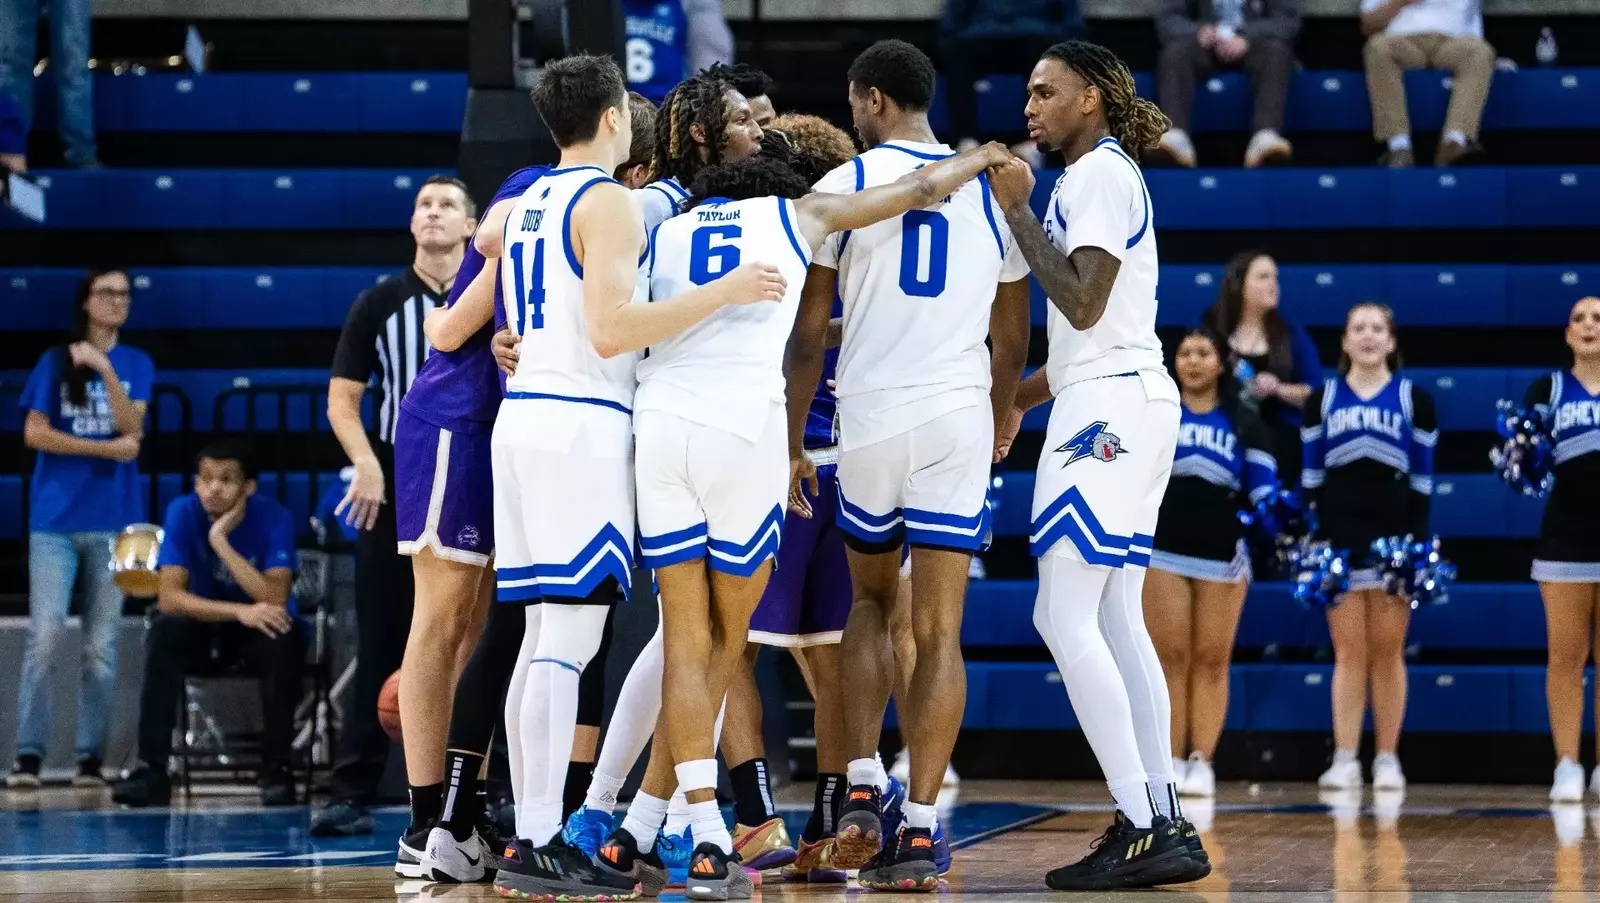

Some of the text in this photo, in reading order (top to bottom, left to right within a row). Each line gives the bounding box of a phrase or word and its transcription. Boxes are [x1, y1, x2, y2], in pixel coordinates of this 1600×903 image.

[520, 208, 547, 233] DUB
[697, 209, 741, 222] TAYLOR
[689, 224, 743, 287] 6
[899, 209, 949, 298] 0
[510, 238, 546, 337] 14
